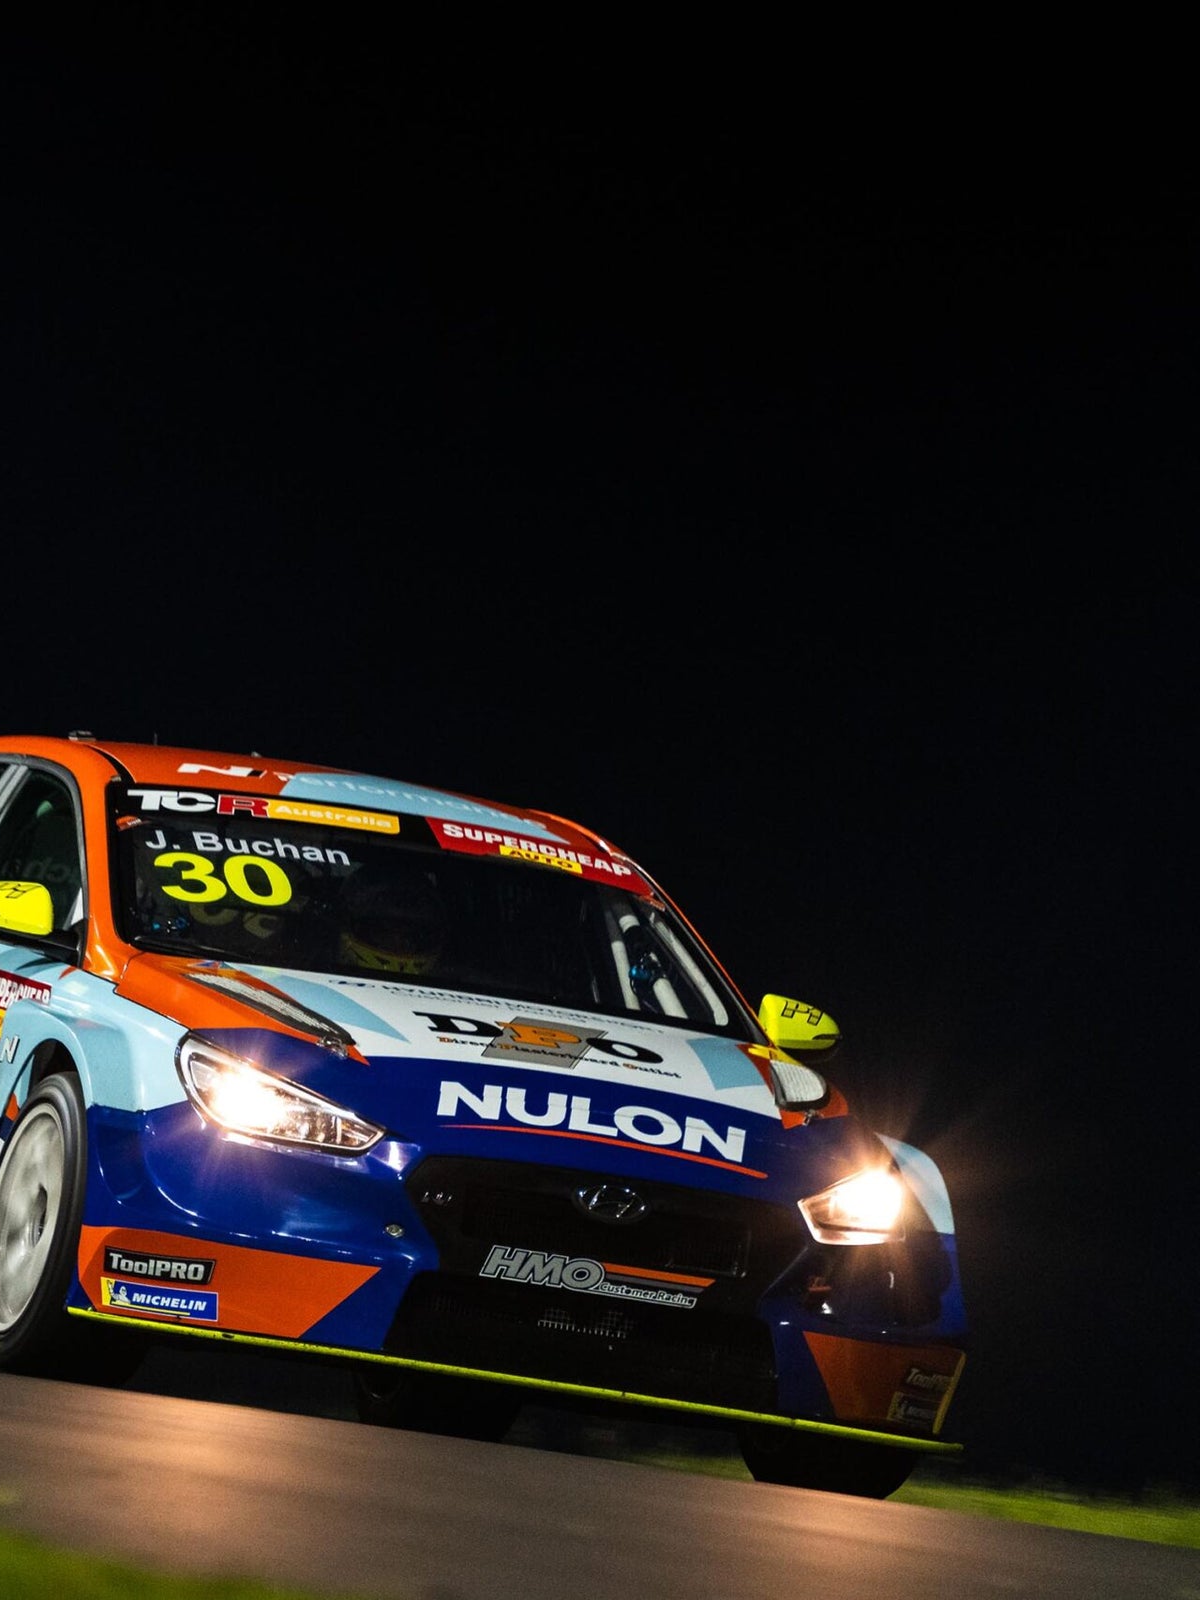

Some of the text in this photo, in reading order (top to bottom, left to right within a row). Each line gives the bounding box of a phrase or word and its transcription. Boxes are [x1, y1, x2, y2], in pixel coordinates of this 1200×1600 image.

[127, 789, 393, 829] TCR Australia
[145, 829, 351, 866] J. Buchan
[442, 823, 632, 877] SUPERCHEAP
[507, 849, 574, 870] AUTO
[154, 852, 292, 906] 30
[436, 1081, 746, 1163] NULON
[109, 1252, 205, 1281] ToolPRO
[482, 1246, 603, 1290] HMO
[132, 1292, 207, 1311] MICHELIN
[658, 1290, 696, 1305] Racing
